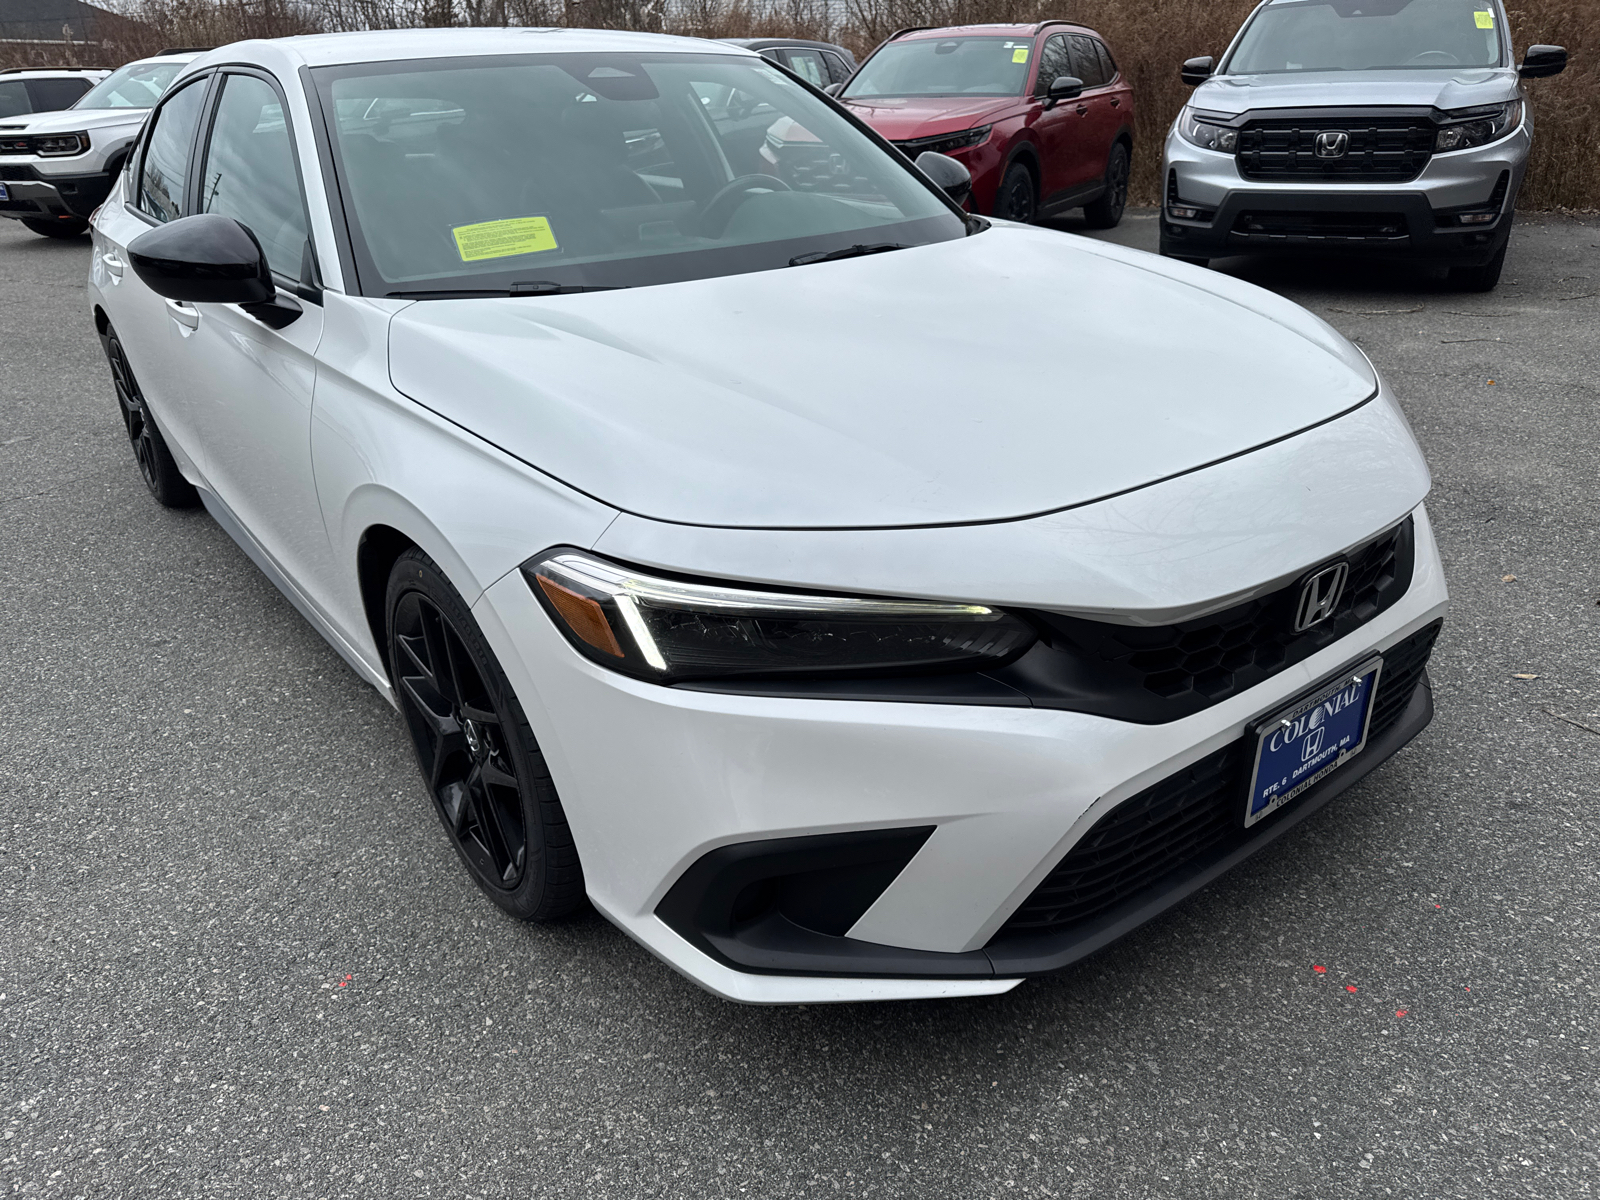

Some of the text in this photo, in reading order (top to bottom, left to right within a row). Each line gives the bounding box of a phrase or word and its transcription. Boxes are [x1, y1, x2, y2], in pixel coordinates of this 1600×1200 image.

[1269, 684, 1360, 752] COLONIAL
[1263, 782, 1280, 798] RTE.
[1281, 777, 1287, 786] 6
[1339, 735, 1350, 747] MA
[1276, 761, 1338, 807] COLONIAL HONDA
